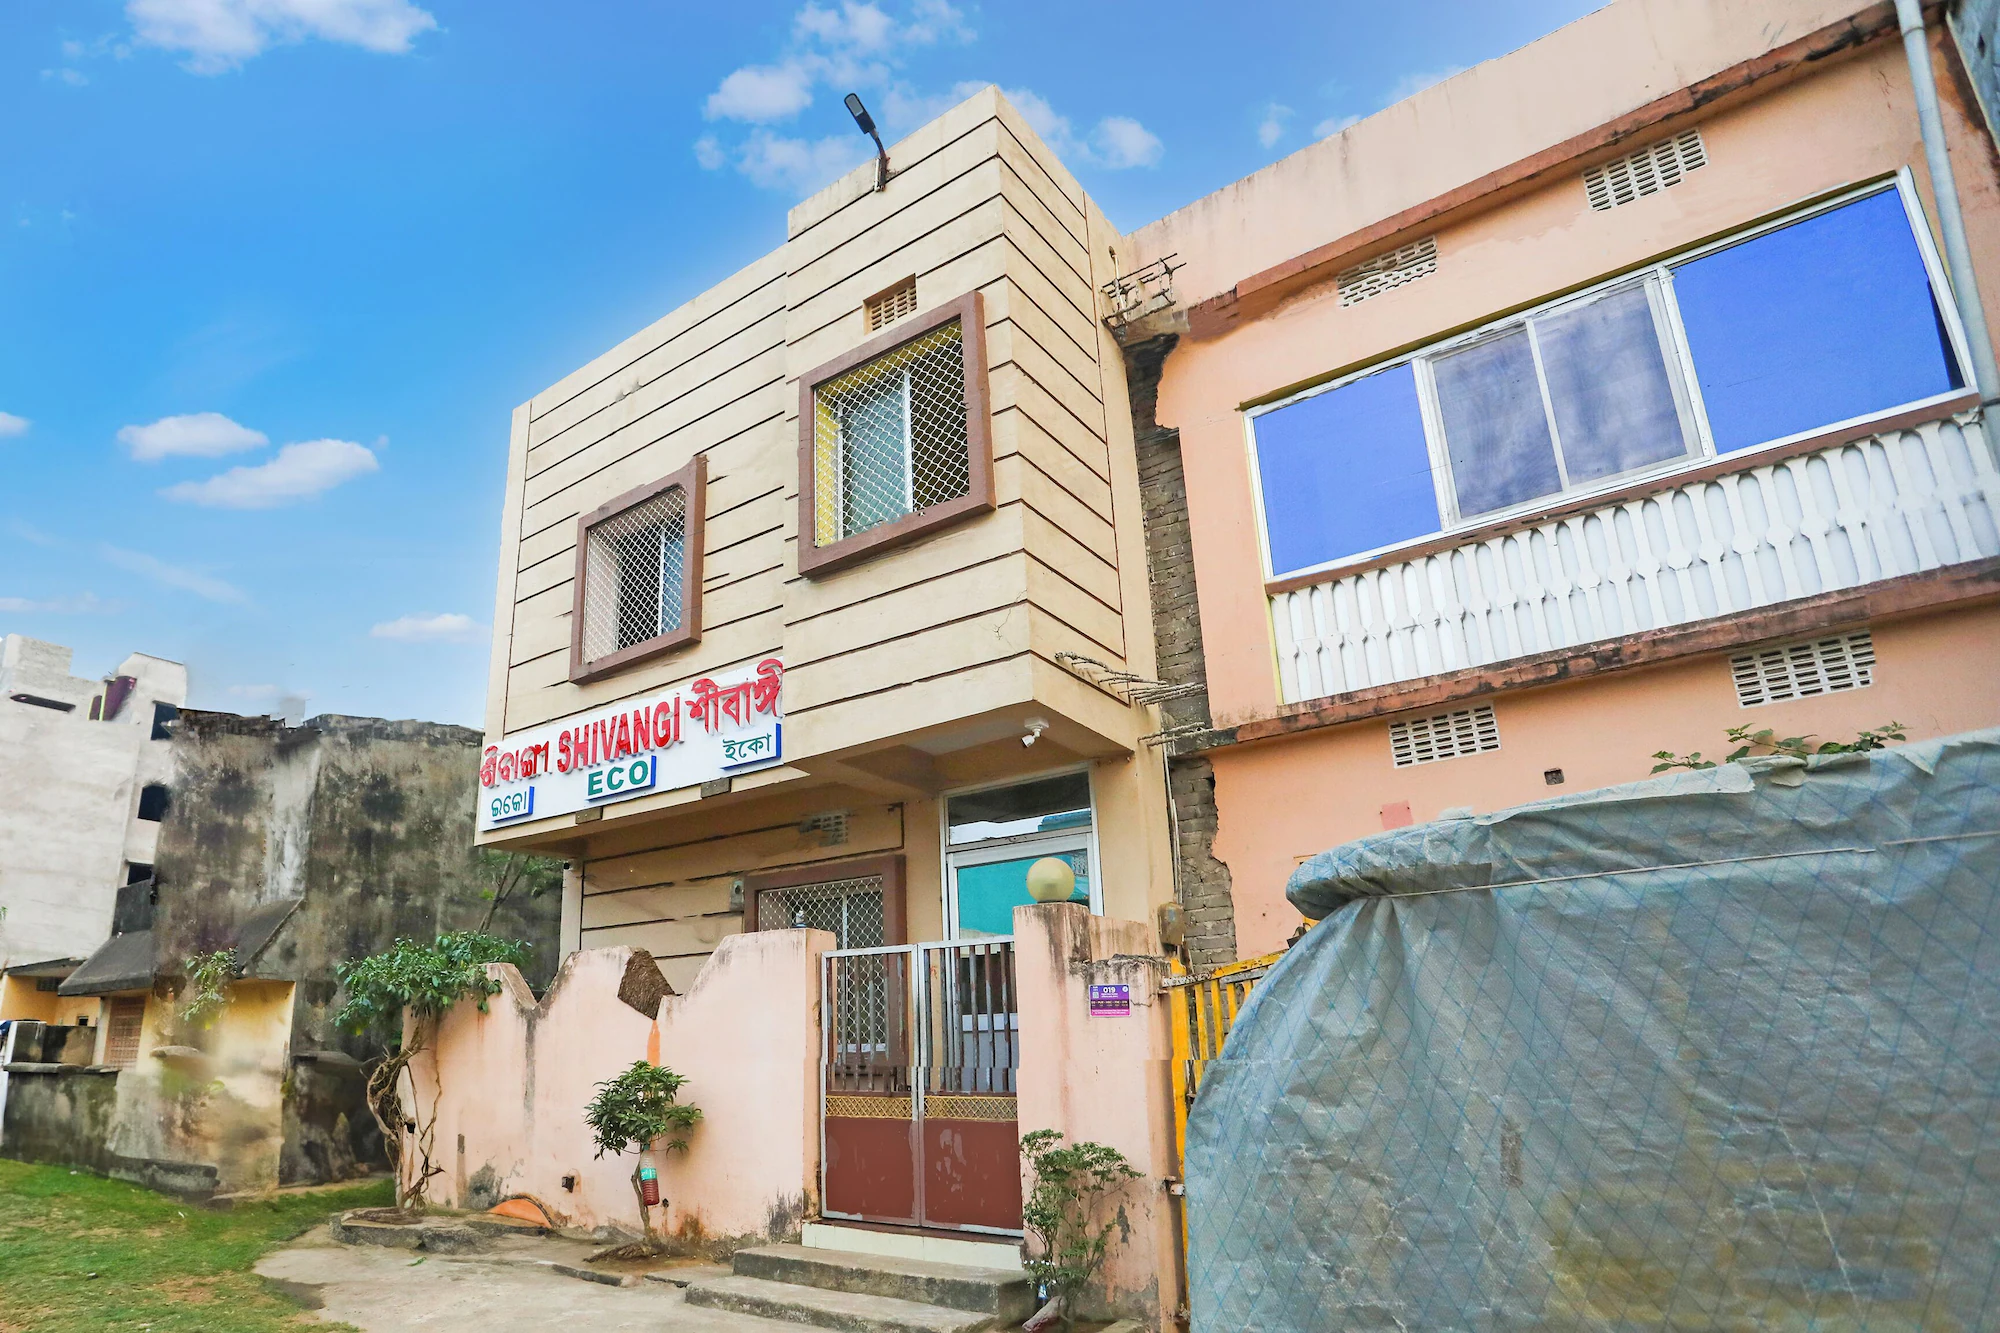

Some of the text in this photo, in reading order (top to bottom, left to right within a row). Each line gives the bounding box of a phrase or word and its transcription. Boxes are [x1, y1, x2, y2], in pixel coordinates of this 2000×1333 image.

[685, 657, 784, 734] শীবাঙ্গী
[557, 694, 682, 774] SHIVANGI
[722, 732, 772, 762] ইকো
[587, 760, 649, 796] ECO
[491, 790, 527, 818] ଇକୋ
